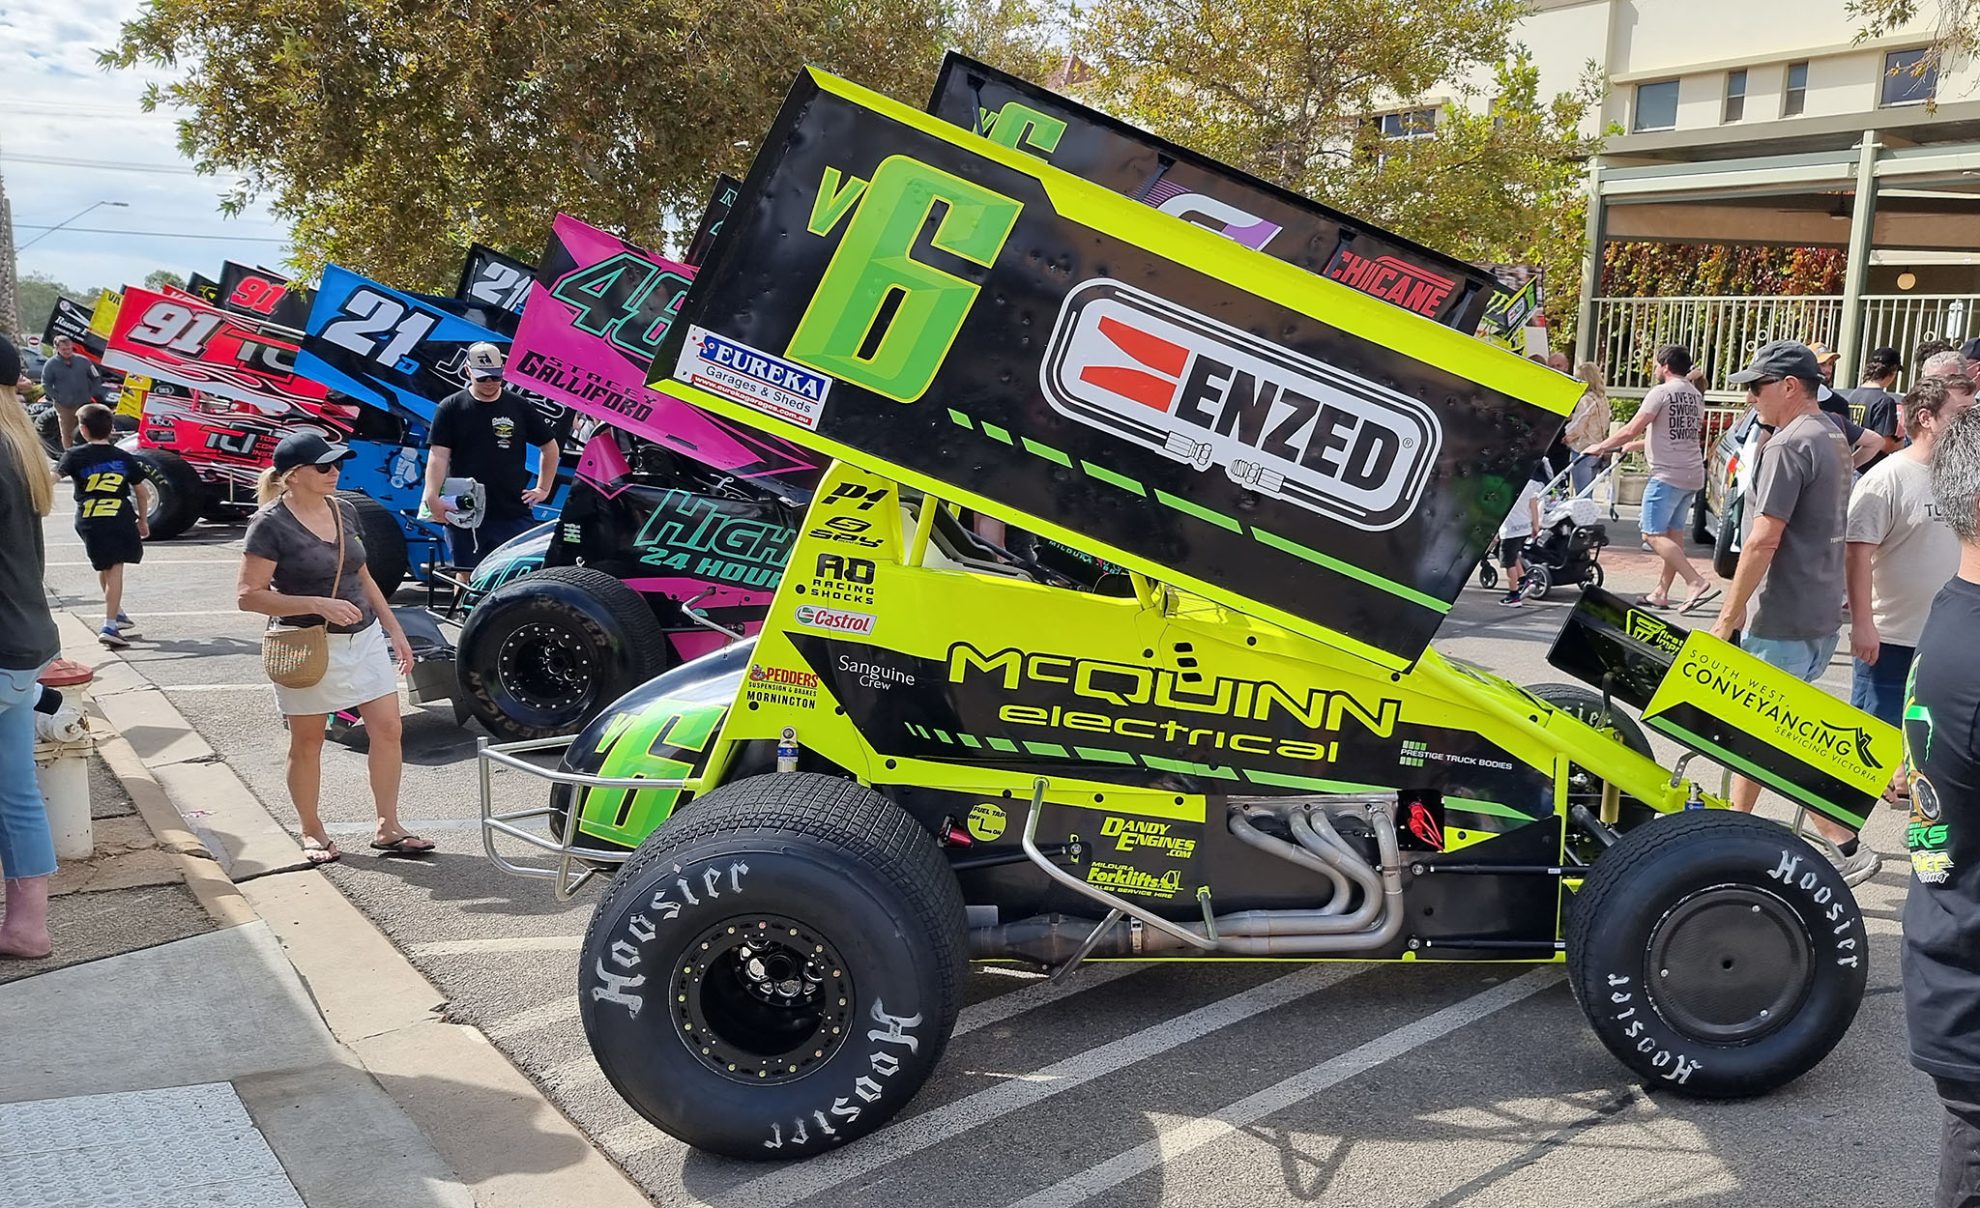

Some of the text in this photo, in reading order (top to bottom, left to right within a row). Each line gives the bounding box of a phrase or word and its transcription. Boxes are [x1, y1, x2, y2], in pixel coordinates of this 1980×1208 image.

[229, 275, 288, 315] 91
[126, 301, 223, 356] 91
[321, 289, 436, 368] 21
[549, 356, 657, 404] STACEY
[714, 343, 818, 400] EUREKA
[516, 349, 654, 422] GALLIFORD
[706, 366, 811, 414] Garages & Sheds
[694, 375, 809, 424] www.eurekagarages.com.au
[1176, 354, 1400, 491] ENZED
[1669, 416, 1685, 428] DIE
[85, 472, 124, 492] 12
[82, 498, 122, 518] 12
[808, 528, 885, 548] SPY
[640, 546, 691, 570] 24
[811, 588, 874, 605] SHOCKS
[813, 578, 875, 596] RACING
[815, 610, 871, 632] Castrol
[766, 667, 819, 688] PEDDERS
[838, 654, 916, 686] Sanguine
[1689, 649, 1786, 702] SOUTH WEST
[748, 681, 787, 693] SUSPENSION
[794, 688, 817, 697] BRAKES
[859, 674, 892, 691] Crew
[746, 690, 816, 710] MORNINGTON
[1682, 661, 1852, 756] CONVEYANCING
[998, 703, 1340, 763] electrical
[1400, 748, 1513, 771] PRESTIGE TRUCK BODIES
[1774, 724, 1878, 783] SERVICING VICTORIA
[973, 806, 1006, 818] FUEL TAP
[991, 828, 1003, 836] ON
[1100, 816, 1171, 837] DANDY
[1115, 832, 1196, 852] ENGINES
[1087, 867, 1160, 888] Forklifts
[1091, 861, 1135, 871] MILDURA
[1117, 887, 1153, 897] SERVICE
[1766, 850, 1859, 969] Hoosier
[592, 859, 750, 1021] Hoosier
[1607, 973, 1703, 1085] Hoosier
[763, 997, 923, 1150] Hoosier
